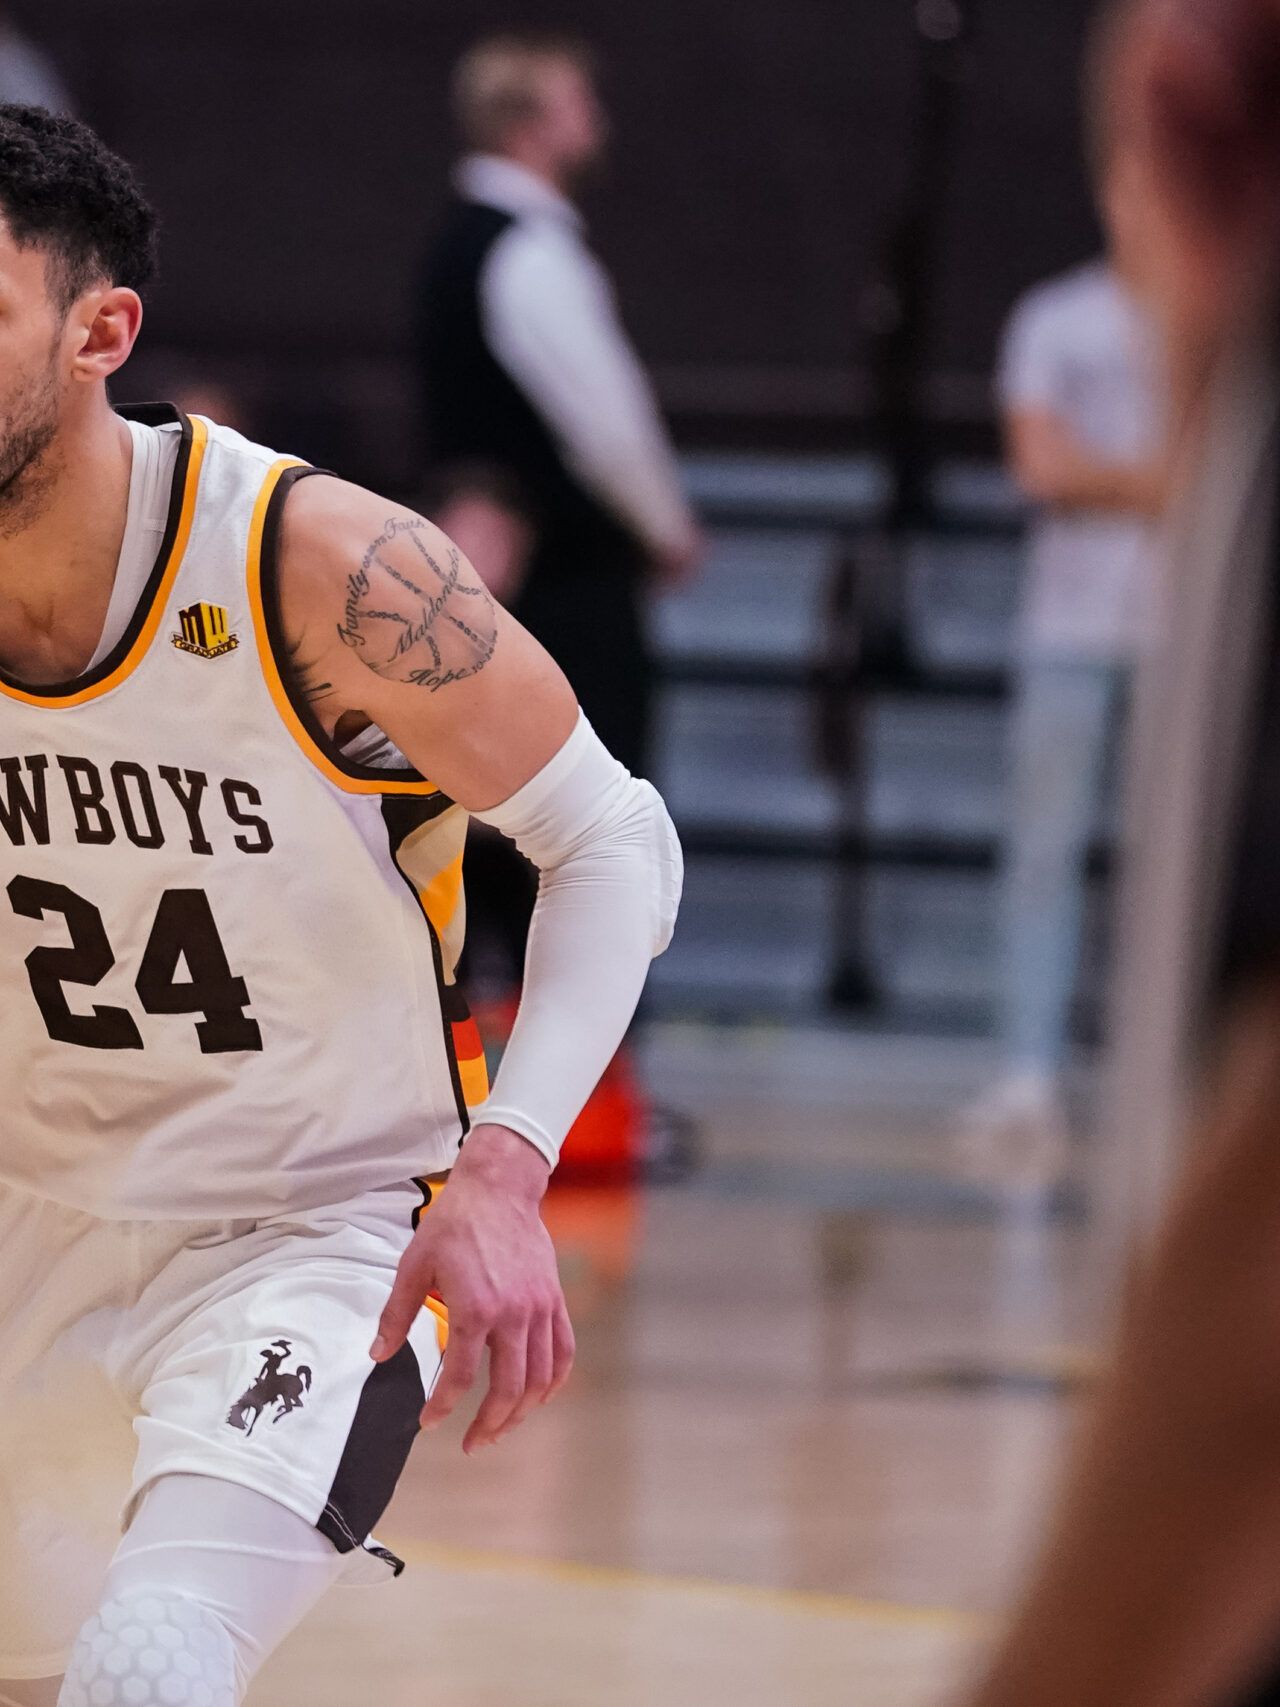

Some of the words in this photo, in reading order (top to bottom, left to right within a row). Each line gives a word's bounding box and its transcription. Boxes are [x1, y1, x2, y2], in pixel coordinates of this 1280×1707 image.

[336, 569, 370, 647] Family
[400, 668, 471, 693] Hope
[6, 874, 263, 1054] 24
